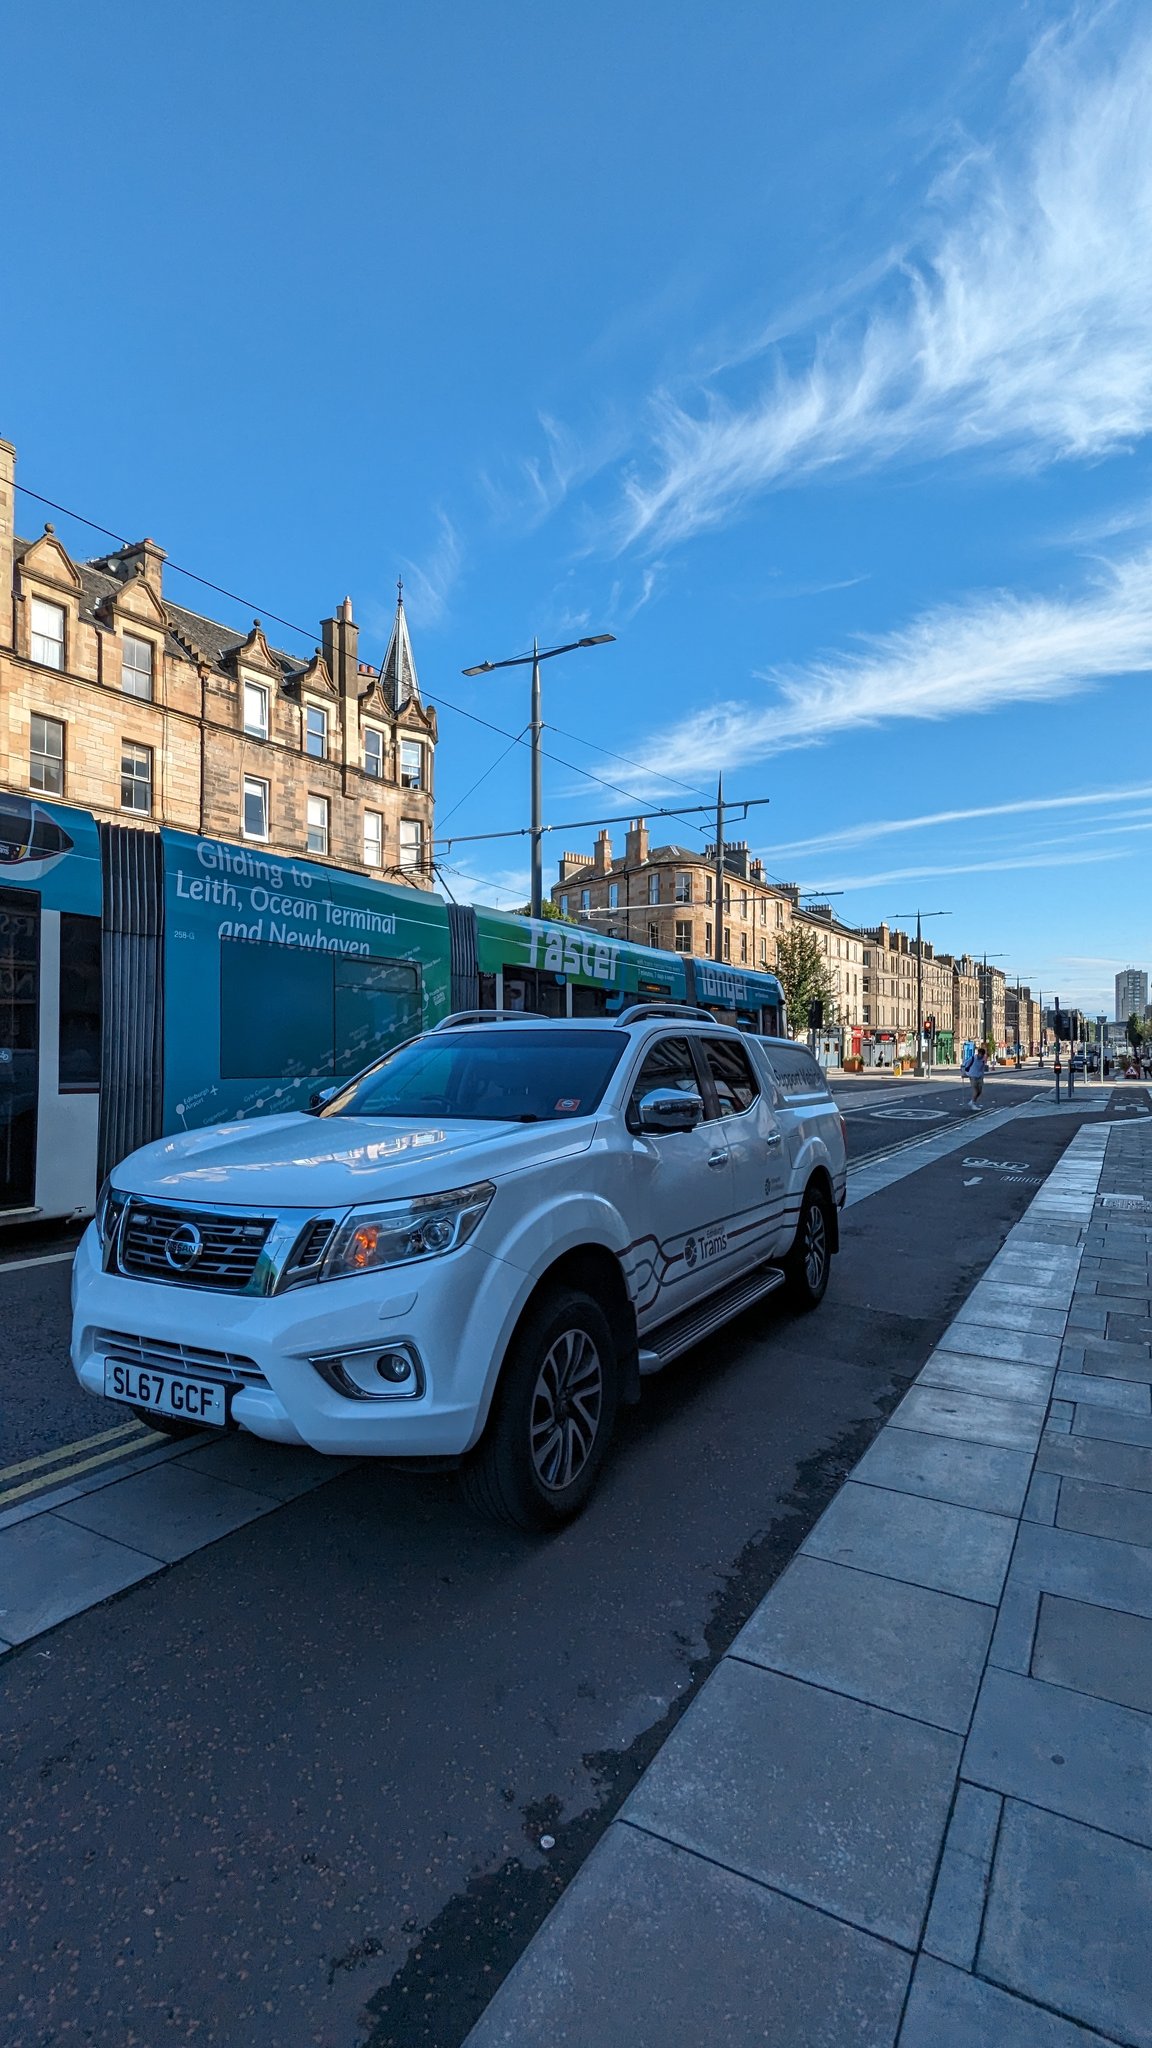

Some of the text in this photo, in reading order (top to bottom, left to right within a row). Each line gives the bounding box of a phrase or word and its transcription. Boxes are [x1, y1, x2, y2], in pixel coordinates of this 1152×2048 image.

[197, 841, 312, 889] Gliding to
[176, 869, 396, 935] Leith, Ocean Terminal
[173, 930, 195, 940] 258-G
[218, 918, 263, 944] and
[269, 921, 370, 960] Newhaven
[529, 917, 621, 981] faster
[701, 966, 749, 1010] longer
[183, 1088, 210, 1105] Edinburgh
[773, 1067, 802, 1090] Support
[185, 1098, 204, 1110] Airport
[698, 1233, 727, 1260] Trams
[113, 1366, 215, 1416] SL67 GCF
